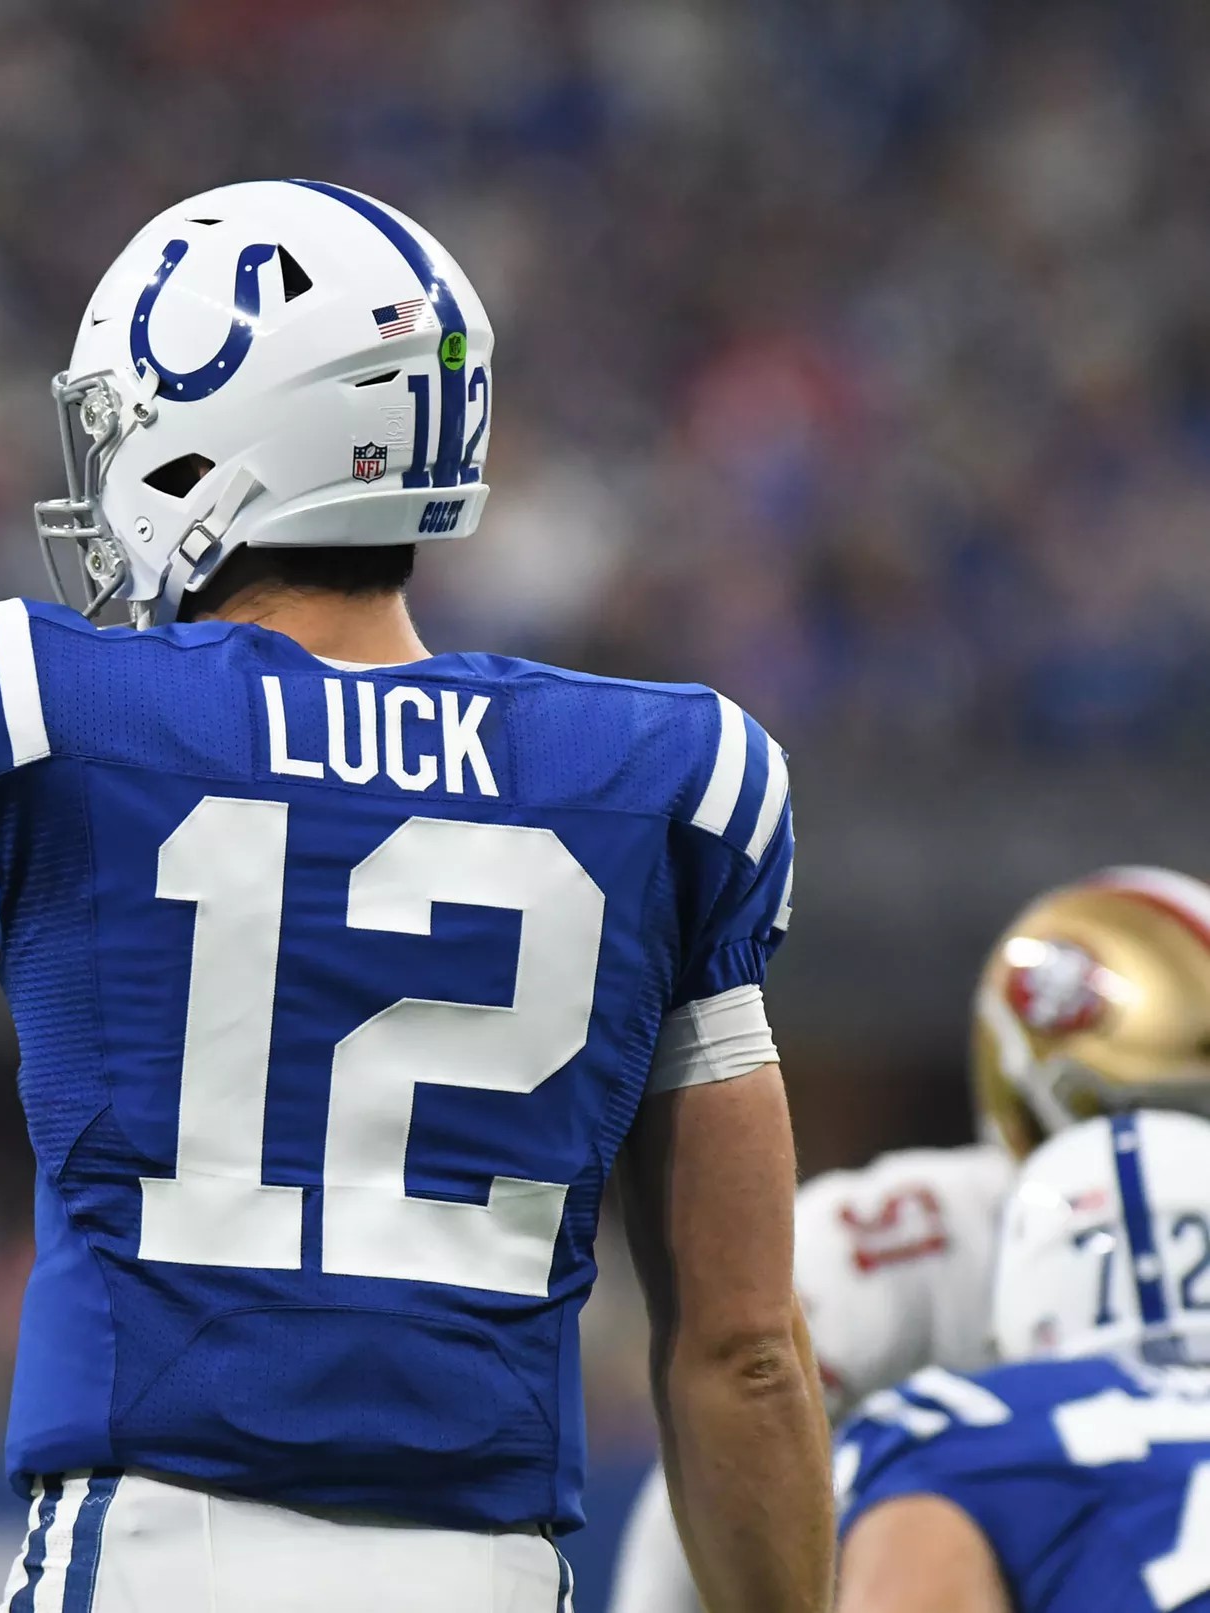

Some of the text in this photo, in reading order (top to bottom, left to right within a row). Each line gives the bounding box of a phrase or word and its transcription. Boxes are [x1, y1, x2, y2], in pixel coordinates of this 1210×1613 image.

[356, 459, 383, 479] NFL
[418, 499, 466, 533] COLTS
[262, 675, 499, 797] LUCK
[138, 796, 605, 1298] 12
